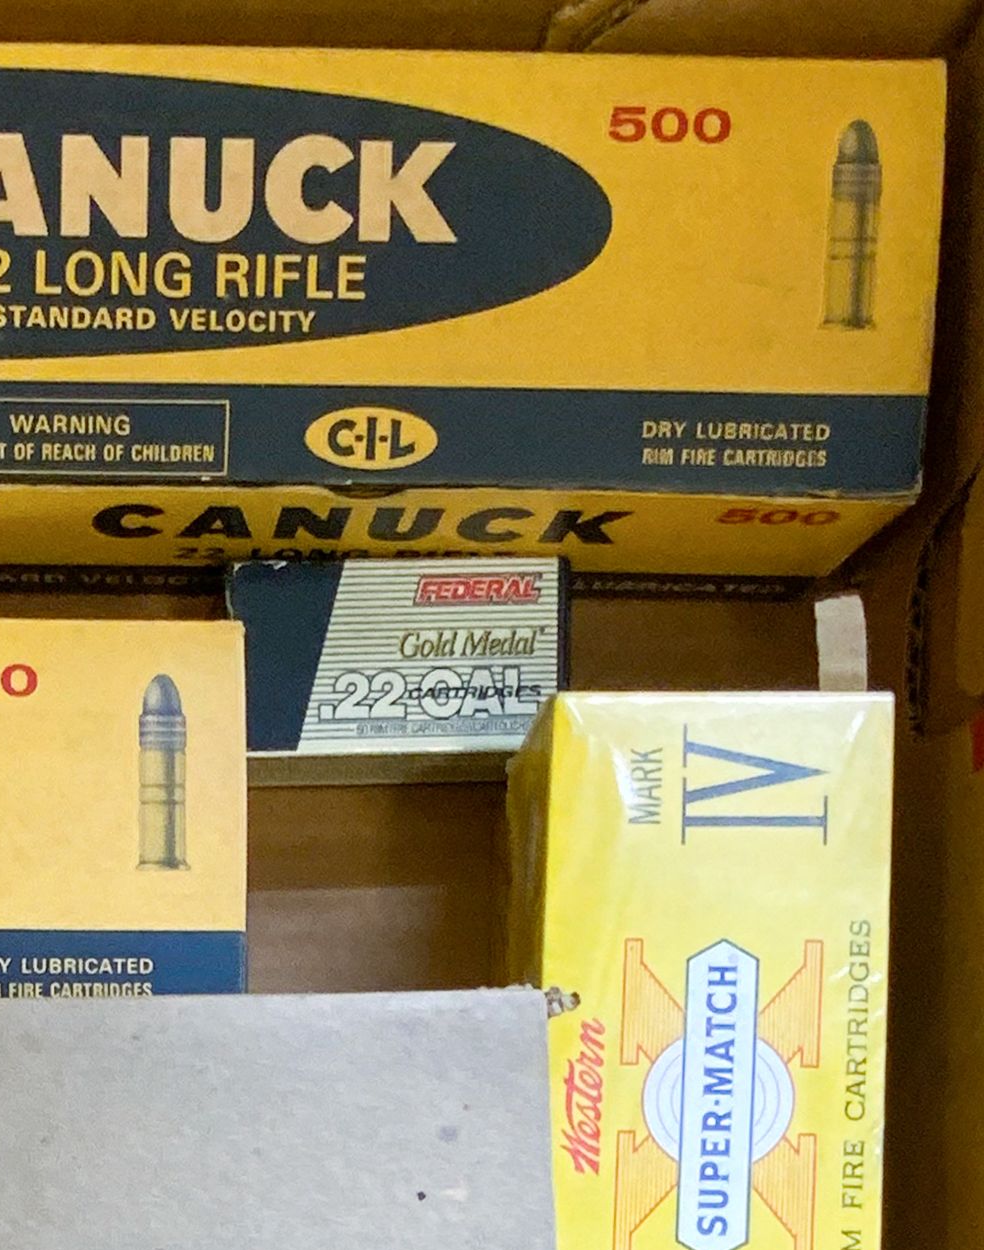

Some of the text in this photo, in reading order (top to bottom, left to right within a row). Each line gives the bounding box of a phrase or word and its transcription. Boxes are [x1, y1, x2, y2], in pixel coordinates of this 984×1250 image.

[608, 106, 732, 145] 500
[35, 250, 192, 298] LONG
[216, 253, 367, 300] RIFLE
[170, 307, 317, 334] VELOCITY
[9, 413, 131, 436] WARNING
[641, 421, 831, 442] DRY LUBRICATED
[14, 442, 35, 460] OF
[42, 442, 96, 462] REACH
[103, 443, 124, 462] OF
[131, 443, 214, 463] CHILDREN
[641, 447, 827, 469] RIM FIRE CARTRIDGES
[92, 503, 637, 545] CANUCK
[716, 506, 841, 527] 500
[417, 575, 542, 603] FEDERAL
[399, 628, 537, 658] Gold Medal
[628, 746, 664, 826] MARK
[681, 723, 829, 846] IV
[21, 957, 154, 975] LUBRICATED
[8, 982, 44, 998] FIRE
[49, 982, 153, 998] CARTRIDGES
[845, 919, 872, 1121] CARTRIDGES
[559, 1017, 605, 1176] Western
[840, 1140, 866, 1222] FIRE
